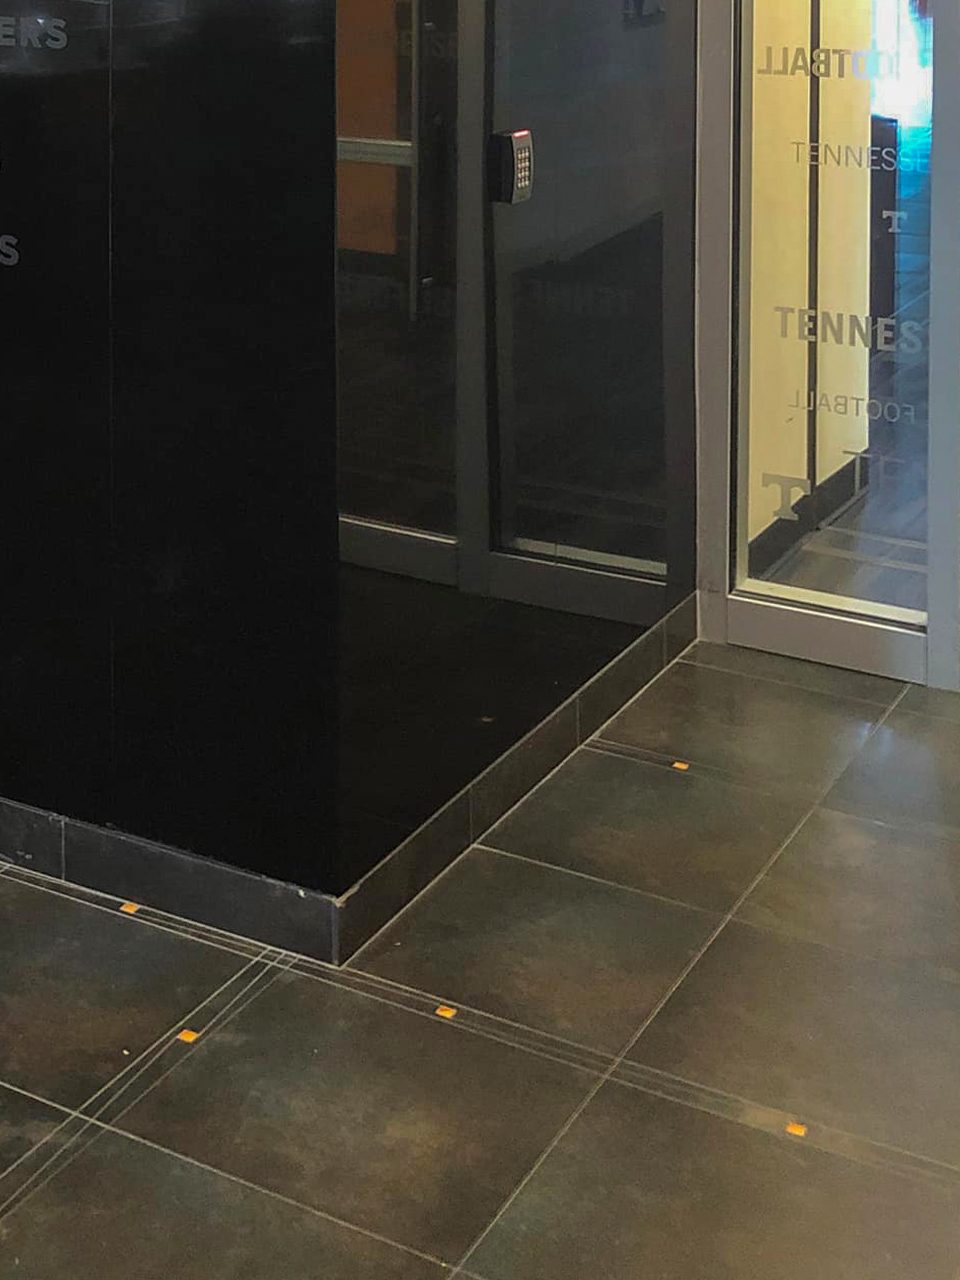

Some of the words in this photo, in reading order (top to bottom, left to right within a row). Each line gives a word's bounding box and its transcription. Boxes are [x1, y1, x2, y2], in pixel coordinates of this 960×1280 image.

[882, 210, 908, 234] T
[773, 305, 924, 354] TENNES
[761, 472, 811, 521] T
